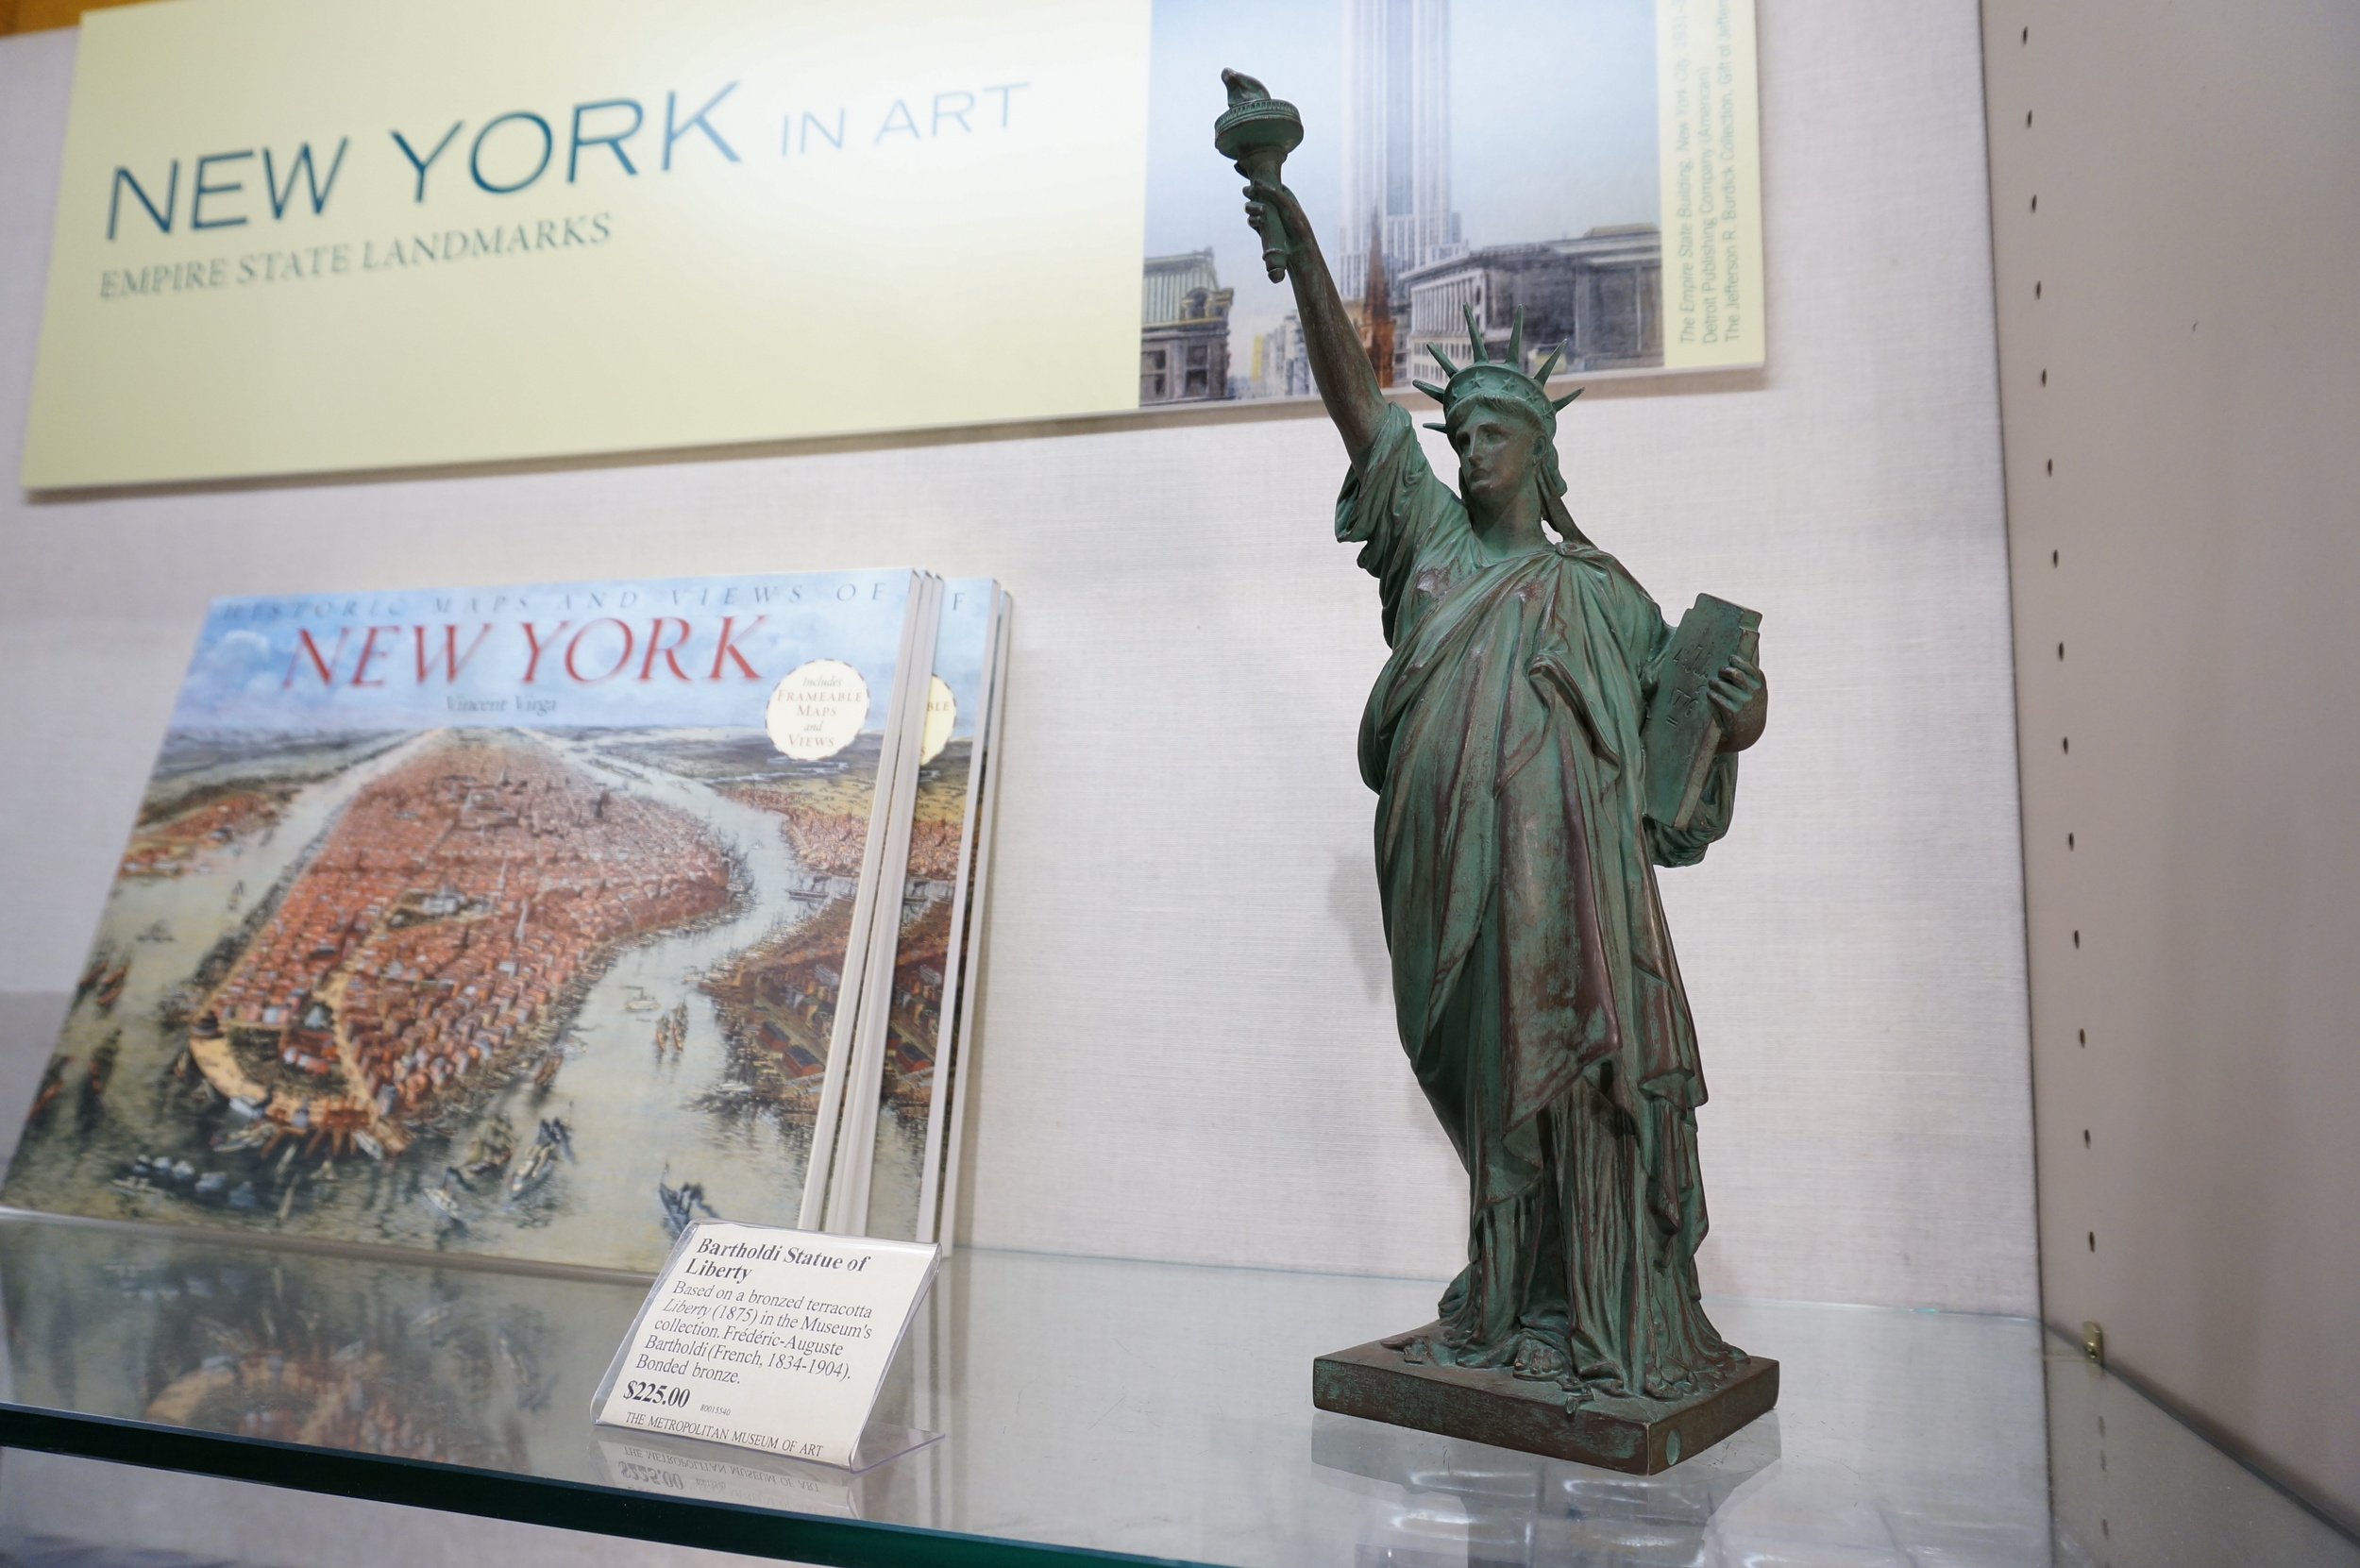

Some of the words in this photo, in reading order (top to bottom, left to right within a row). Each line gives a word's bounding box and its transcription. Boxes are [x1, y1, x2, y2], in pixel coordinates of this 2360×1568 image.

[1718, 61, 1732, 84] Gift
[1696, 66, 1712, 143] (American)
[1676, 123, 1690, 151] New
[106, 137, 348, 240] NEW
[392, 81, 741, 203] YORK
[781, 107, 845, 157] IN
[874, 82, 1031, 144] ART
[1698, 147, 1714, 214] Company
[1721, 163, 1737, 219] Burdick
[99, 257, 229, 299] EMPIRE
[236, 244, 352, 285] STATE
[362, 211, 611, 272] LANDMARKS
[1677, 223, 1694, 261] State
[1701, 217, 1718, 292] Publishing
[1678, 261, 1695, 312] Empire
[1724, 245, 1739, 308] Jefferson
[1679, 316, 1695, 344] The
[1702, 296, 1718, 344] Detroit
[1725, 315, 1740, 343] The
[433, 594, 529, 615] MAPS
[556, 589, 638, 611] AND
[672, 584, 802, 606] VIEWS
[836, 582, 886, 601] OF
[283, 621, 493, 687] NEW
[520, 615, 768, 685] YORK
[777, 689, 863, 702] FRAMEABLE
[802, 674, 843, 688] Includes
[447, 695, 506, 714] Vincent
[514, 694, 558, 717] Virga
[797, 704, 837, 717] MAPS
[788, 733, 835, 748] VIEWS
[803, 720, 824, 733] and
[684, 1258, 752, 1284] Liberty
[696, 1238, 783, 1261] Bartholdi
[784, 1247, 843, 1270] Statue
[847, 1256, 871, 1272] of
[672, 1280, 716, 1298] Based
[716, 1289, 733, 1300] on
[736, 1291, 745, 1302] a
[748, 1290, 805, 1309] bronzed
[806, 1299, 872, 1319] terracotta
[654, 1318, 720, 1339] collection.
[723, 1325, 844, 1356] Frédéric-Auguste
[662, 1298, 712, 1320] Liberty
[712, 1304, 758, 1326] (1875)
[759, 1310, 774, 1325] in
[776, 1313, 799, 1328] the
[800, 1316, 872, 1340] Museum's
[635, 1354, 690, 1375] Bonded
[691, 1362, 740, 1384] bronze.
[644, 1334, 709, 1357] Bartholdi
[707, 1344, 763, 1368] (French,
[767, 1353, 851, 1382] 1834-1904).
[623, 1379, 691, 1408] $225.00
[626, 1411, 647, 1425] THE
[648, 1415, 729, 1440] METROPOLITAN
[732, 1430, 780, 1449] MUSEUM
[782, 1439, 798, 1452] OF
[800, 1443, 824, 1457] ART
